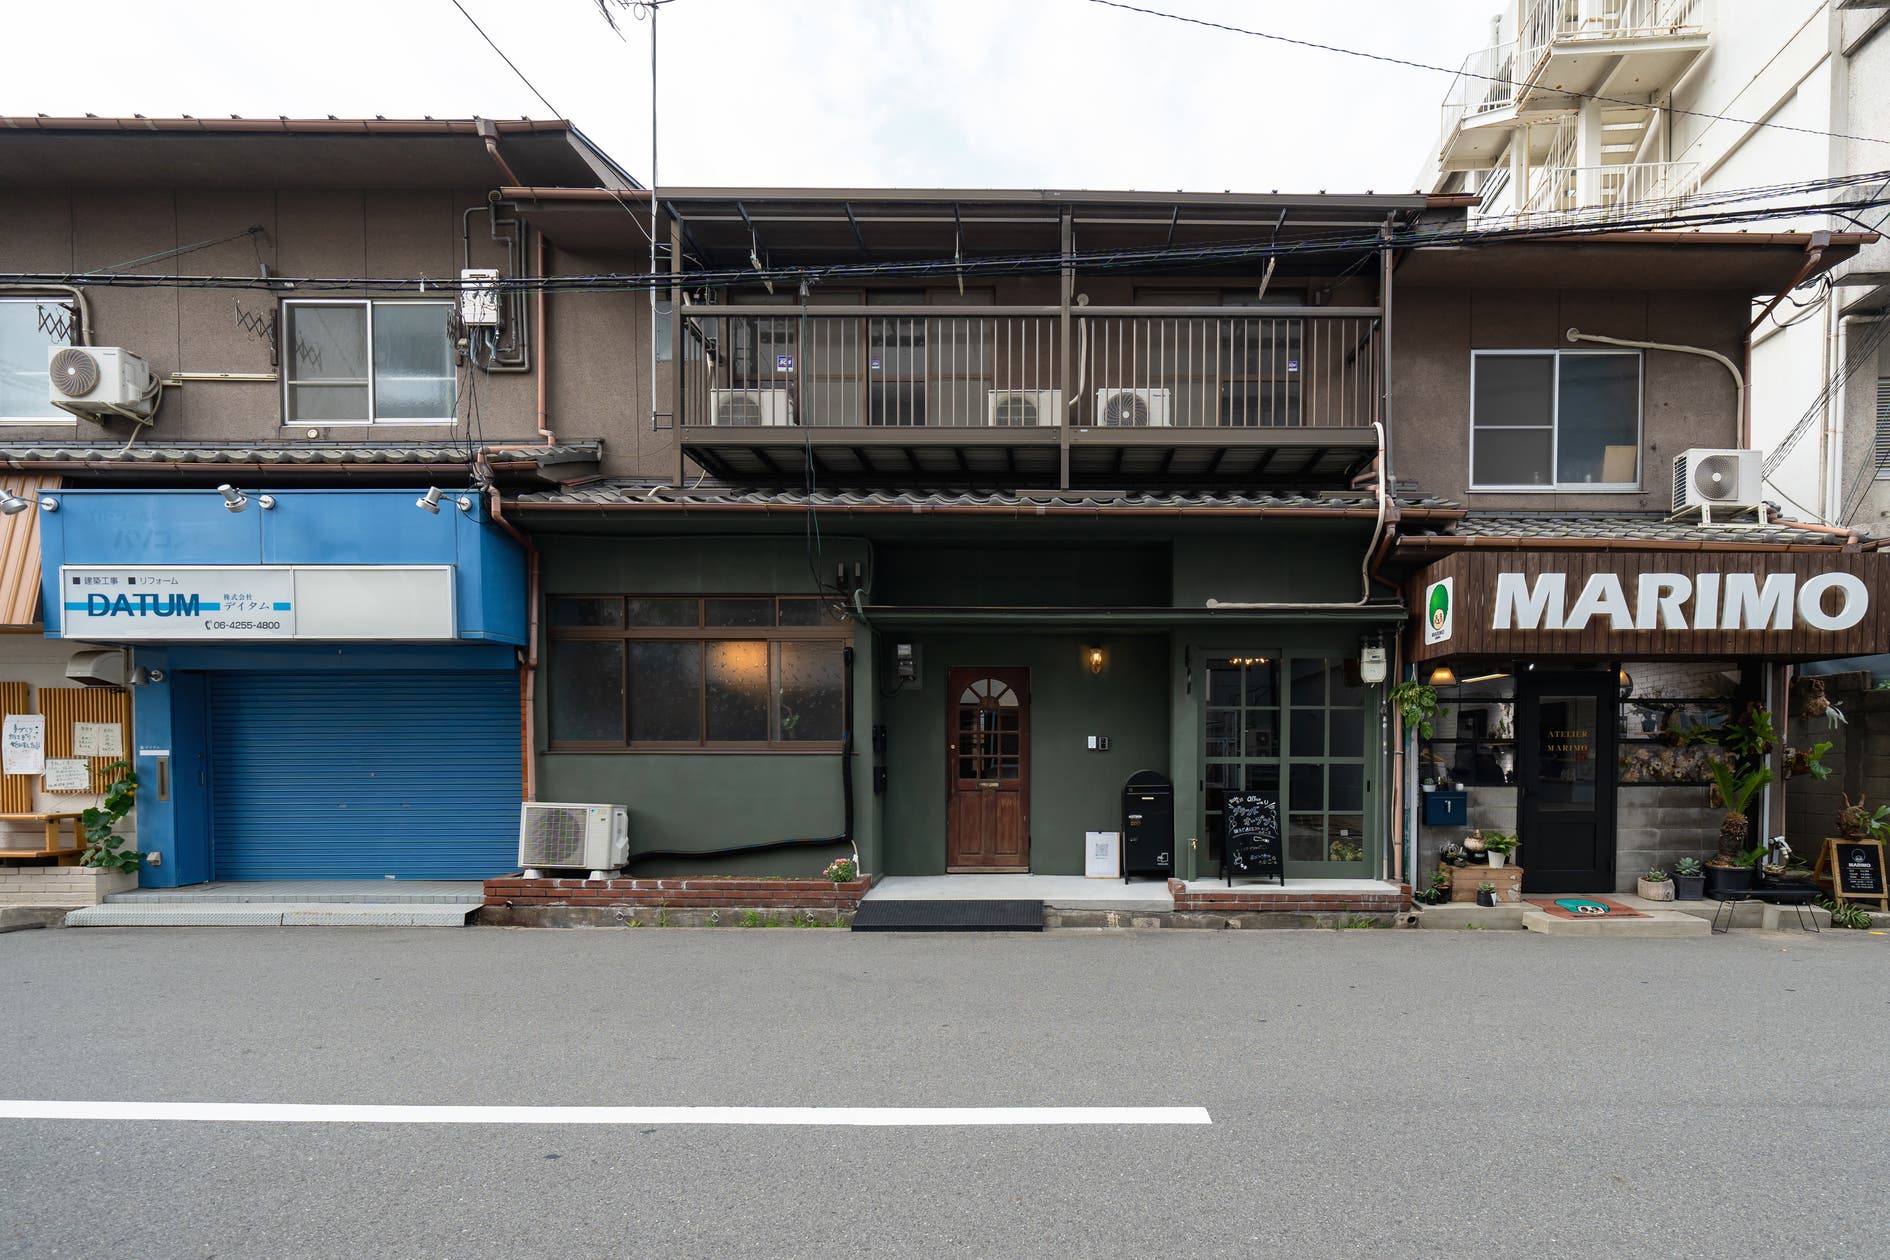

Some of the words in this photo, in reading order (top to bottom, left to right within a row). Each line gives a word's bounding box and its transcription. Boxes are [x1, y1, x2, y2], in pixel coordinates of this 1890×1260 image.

[84, 577, 118, 585] 建築工事
[139, 577, 179, 585] リフォーム
[223, 593, 252, 601] 株式会社
[1492, 572, 1869, 631] MARIMO
[87, 593, 200, 617] DATUM
[213, 621, 280, 630] 06-4255-4800
